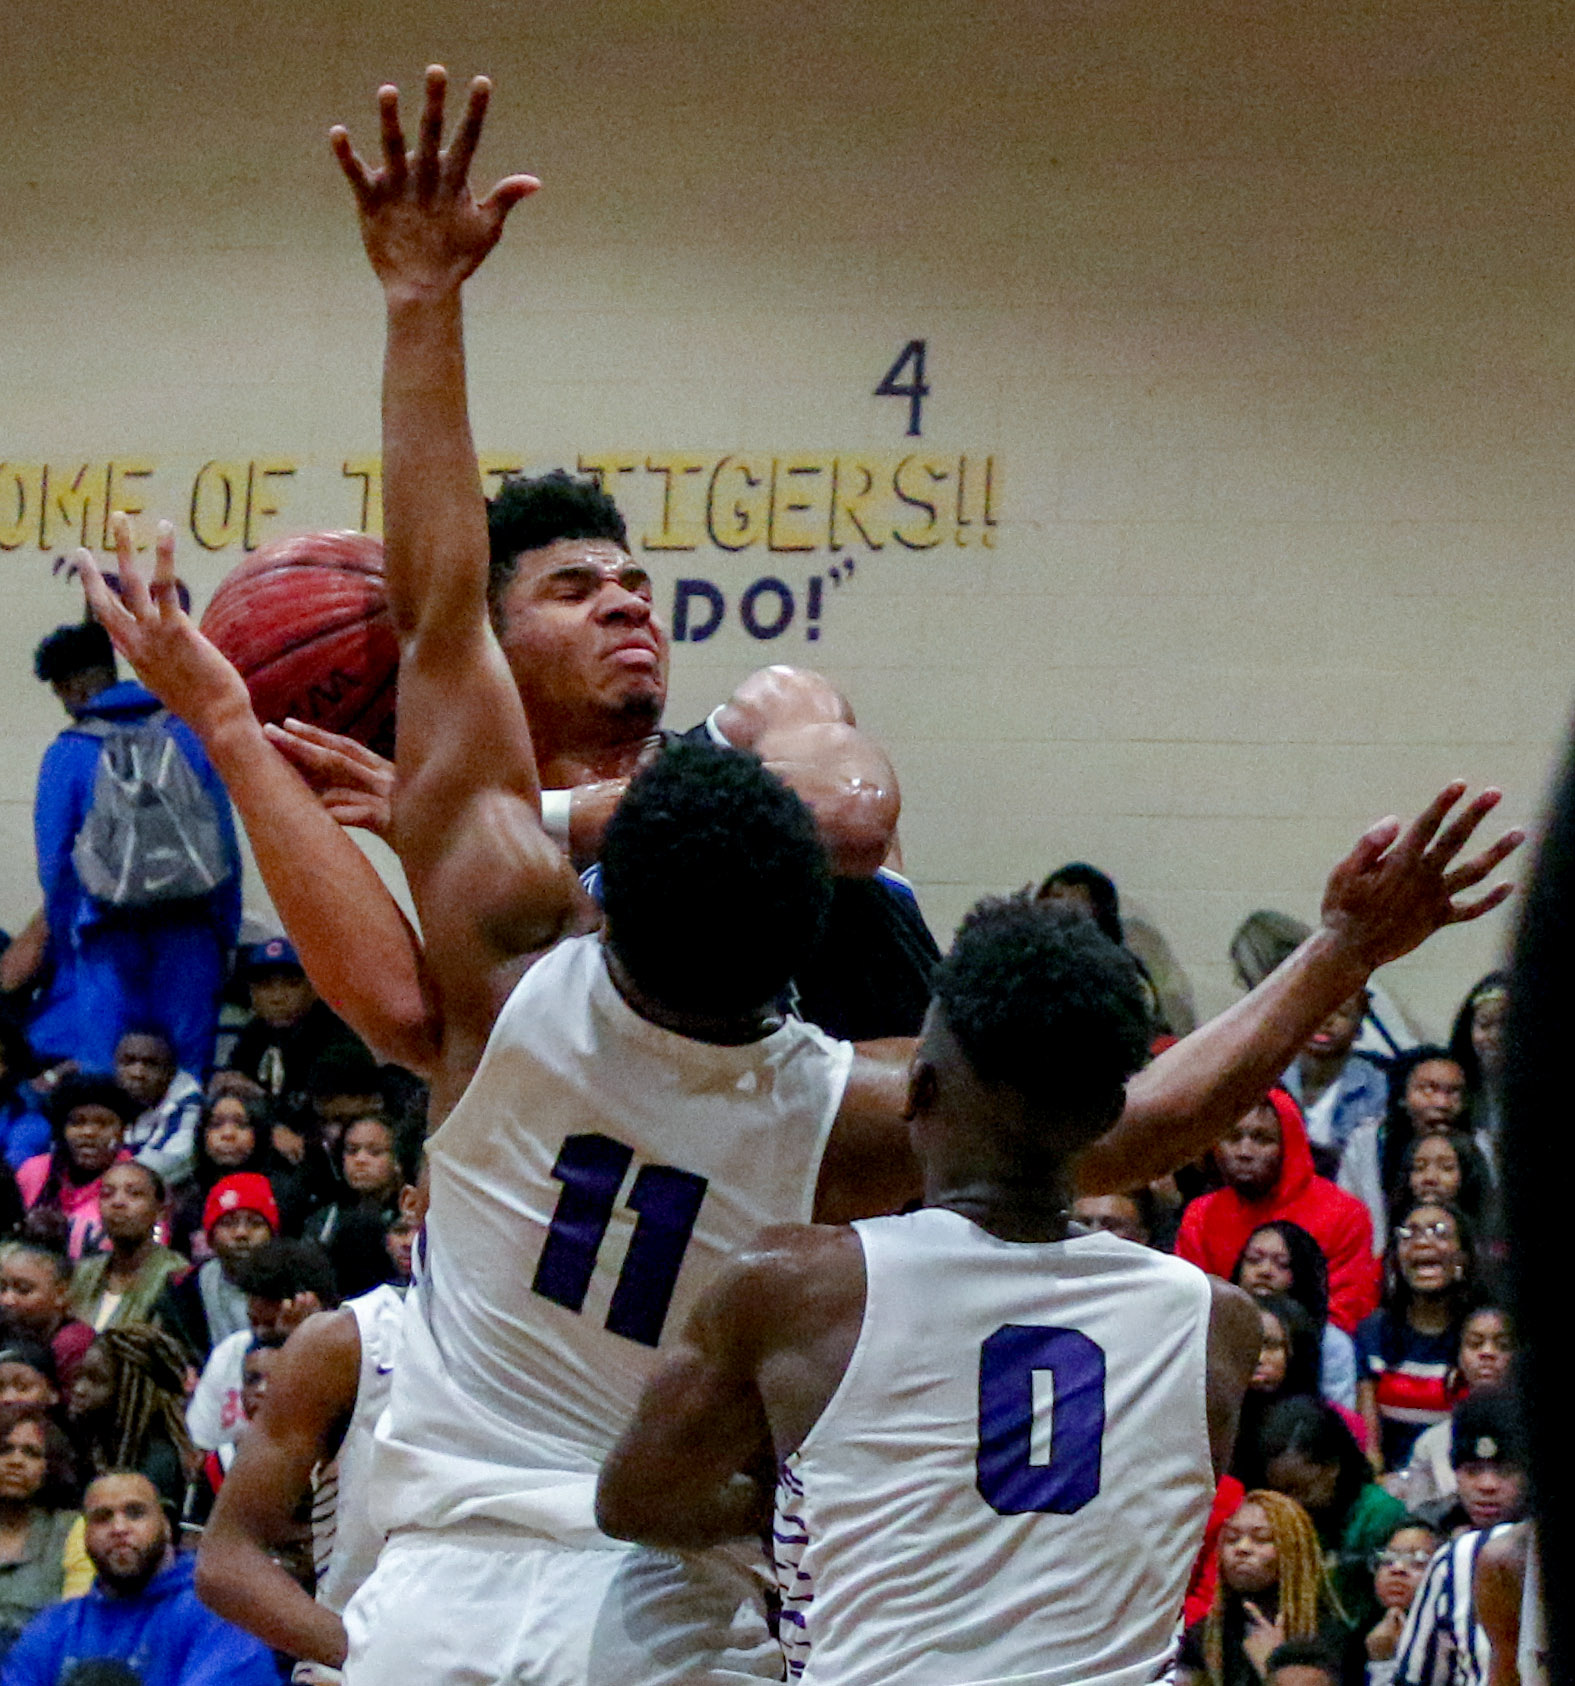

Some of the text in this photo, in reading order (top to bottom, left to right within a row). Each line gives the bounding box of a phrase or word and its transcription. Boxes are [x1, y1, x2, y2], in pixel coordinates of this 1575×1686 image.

[873, 338, 931, 437] 4
[190, 459, 297, 552] OF
[530, 1131, 710, 1349] 11
[975, 1322, 1107, 1516] 0
